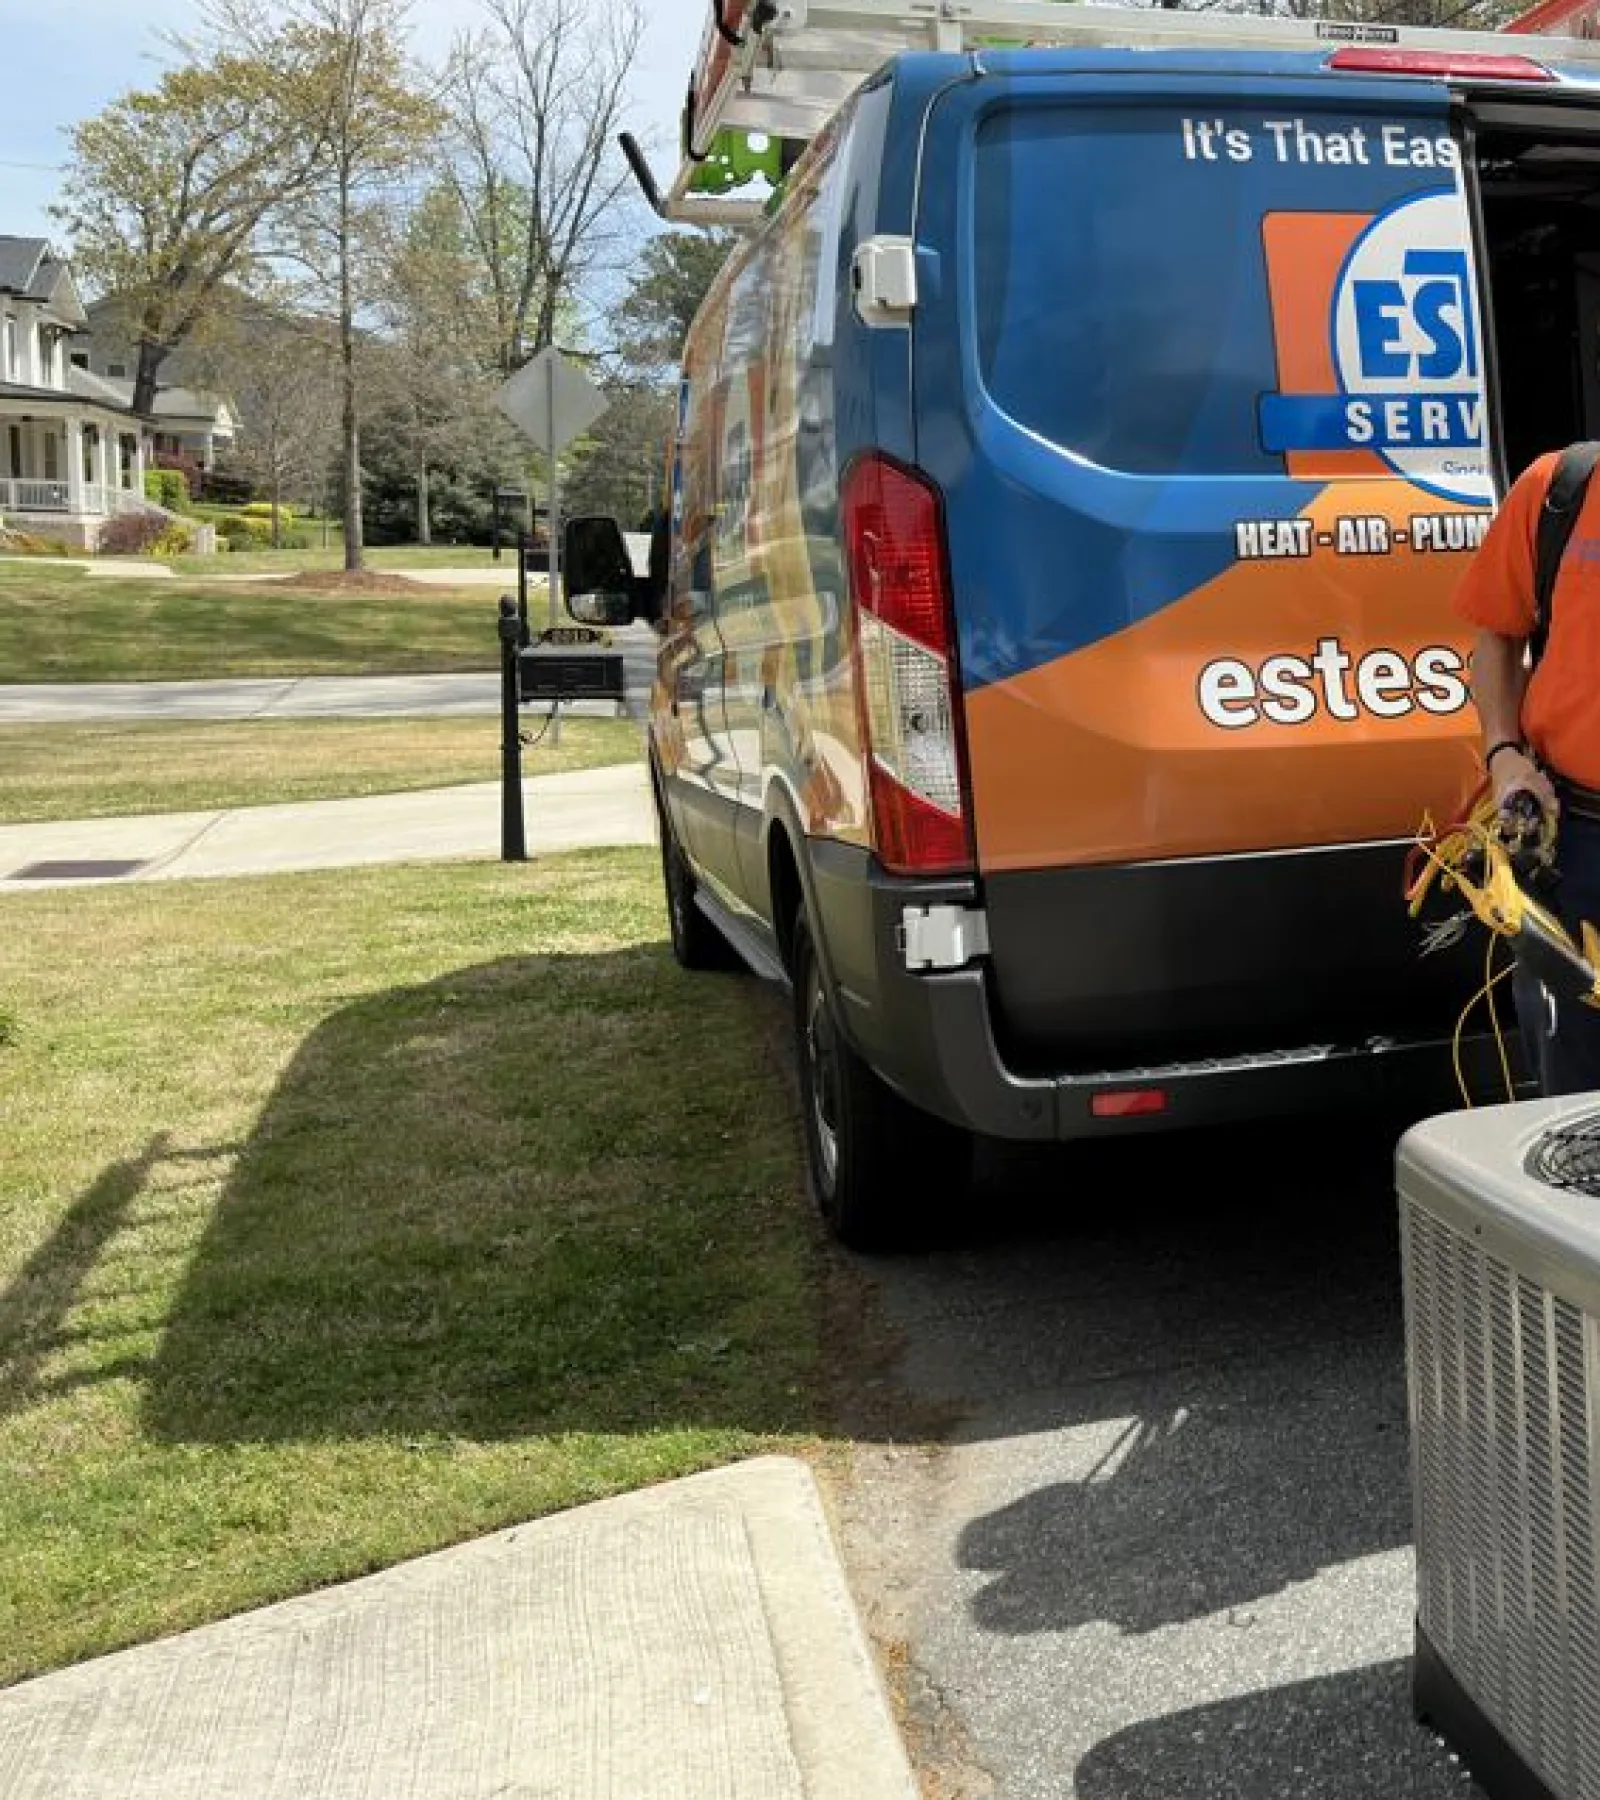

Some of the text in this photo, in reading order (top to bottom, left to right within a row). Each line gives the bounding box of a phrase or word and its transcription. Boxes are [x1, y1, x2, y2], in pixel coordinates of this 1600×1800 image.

[1180, 117, 1253, 162] It's
[1262, 118, 1370, 165] That
[1235, 518, 1313, 559] HEAT
[1337, 515, 1390, 554] AIR
[1198, 636, 1472, 729] estes
